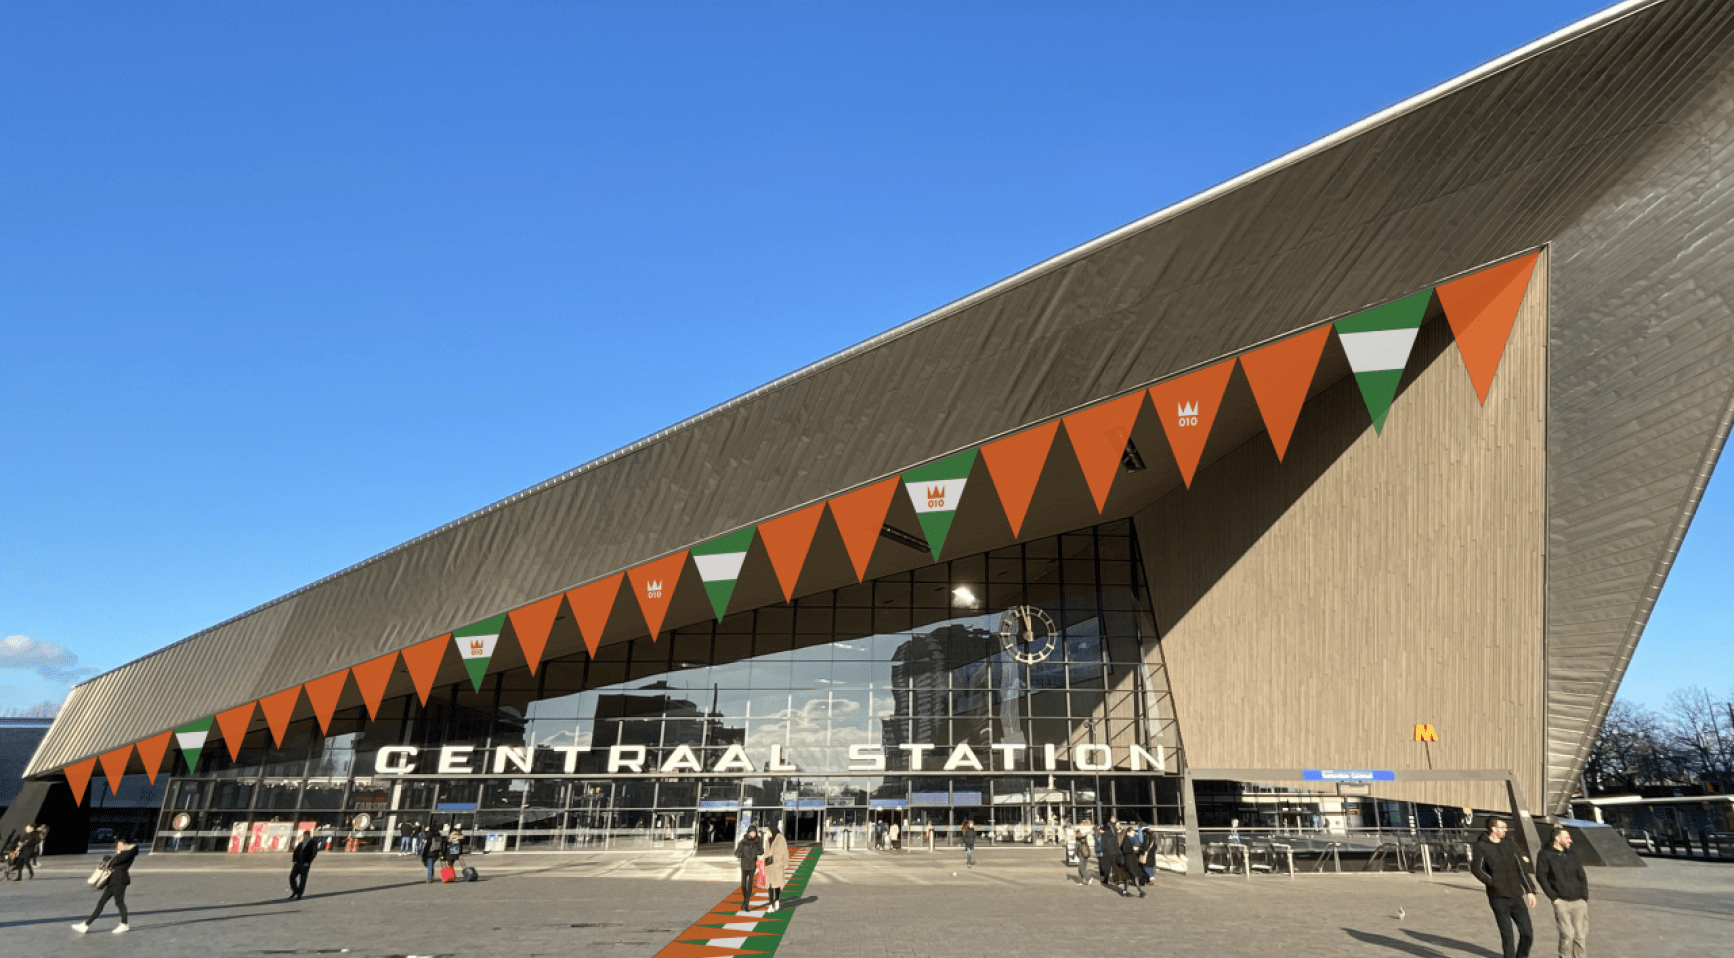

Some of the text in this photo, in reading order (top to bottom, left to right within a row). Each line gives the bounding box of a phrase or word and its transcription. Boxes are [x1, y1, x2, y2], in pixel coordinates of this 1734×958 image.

[1178, 416, 1198, 427] 010
[928, 498, 945, 509] 010
[648, 590, 662, 599] 010
[1413, 723, 1439, 742] M
[375, 743, 1167, 774] CENTRAAL STATION
